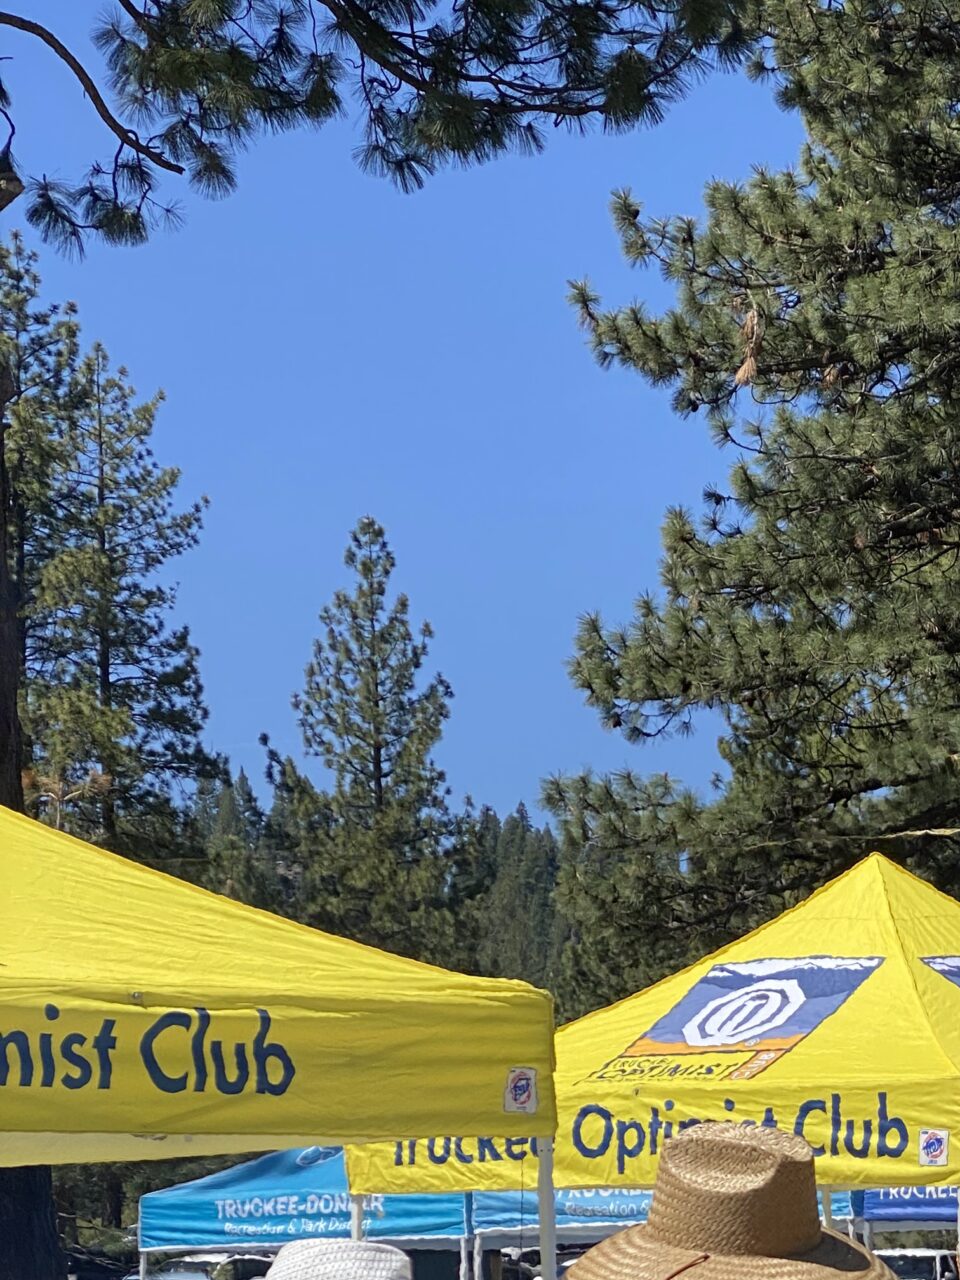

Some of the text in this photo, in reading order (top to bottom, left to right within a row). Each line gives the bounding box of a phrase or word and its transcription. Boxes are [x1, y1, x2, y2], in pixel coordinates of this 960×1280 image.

[140, 1007, 296, 1096] Club
[731, 1051, 776, 1080] CLUB
[794, 1092, 909, 1158] Club
[287, 1218, 297, 1234] &
[301, 1217, 327, 1234] Park
